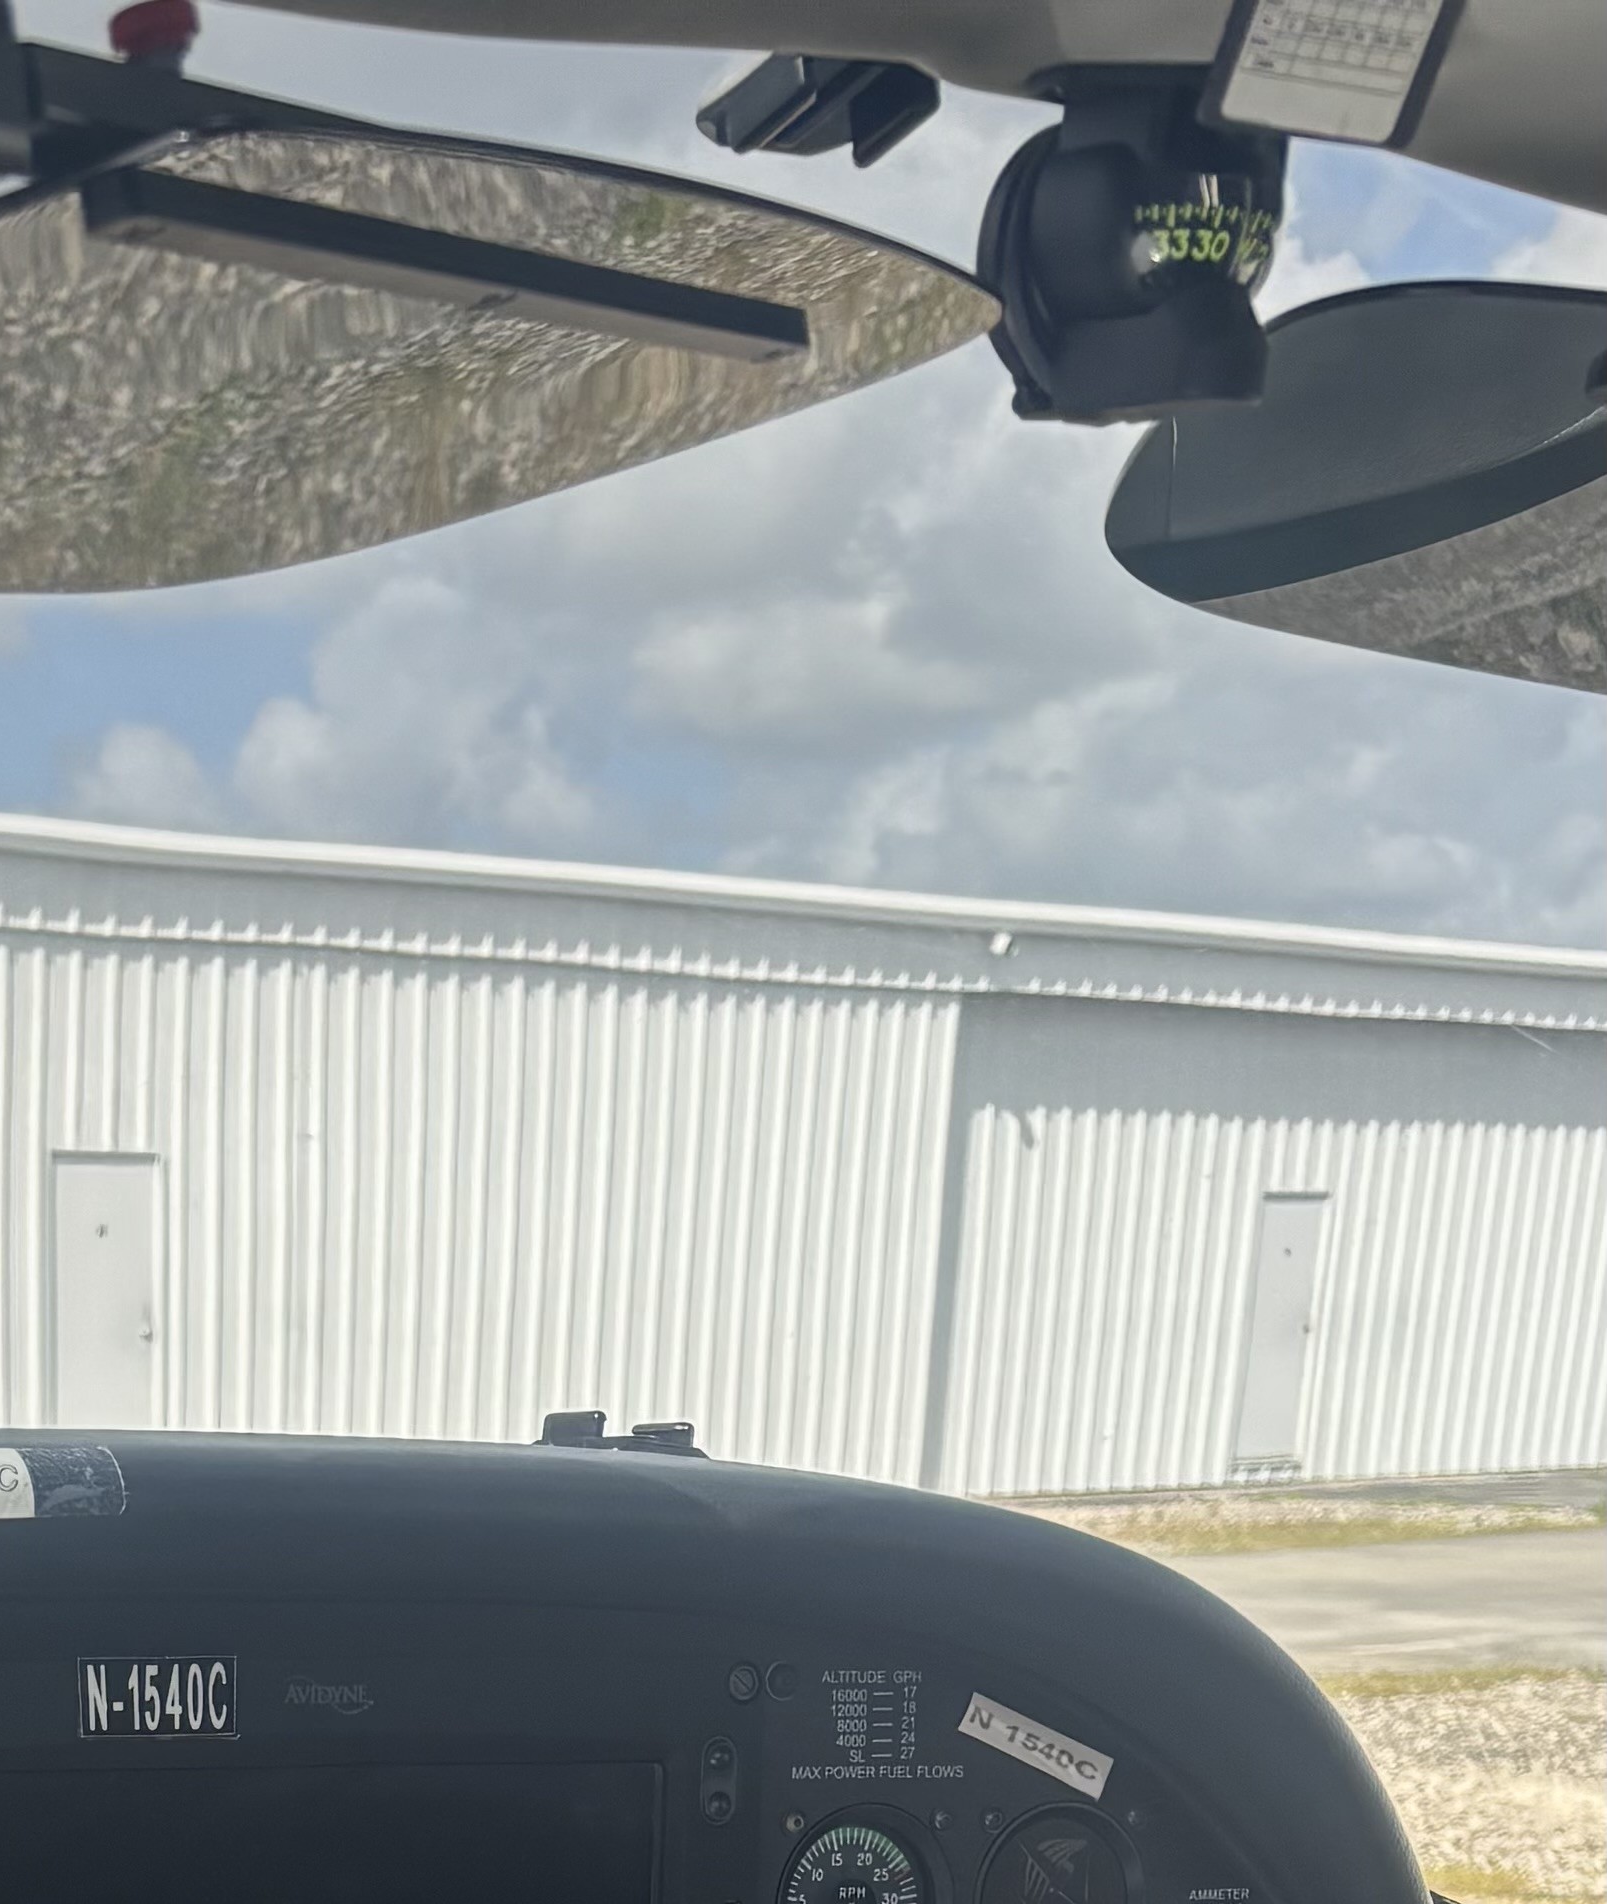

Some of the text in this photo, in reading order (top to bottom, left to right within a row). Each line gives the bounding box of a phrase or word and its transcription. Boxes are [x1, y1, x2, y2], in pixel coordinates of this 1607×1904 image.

[822, 1670, 922, 1684] ALTITUDE GPH
[87, 1662, 228, 1732] N-1540C
[831, 1689, 868, 1702] 16000
[831, 1704, 868, 1717] 12000
[837, 1719, 867, 1732] 8000
[836, 1735, 866, 1747] 4000
[969, 1706, 1099, 1781] N 1540C
[792, 1765, 964, 1779] MAX POWER FUEL FLOWS
[857, 1853, 873, 1866] 20
[873, 1869, 889, 1881] 25
[839, 1887, 866, 1899] RPM
[1189, 1888, 1249, 1901] AMMETER
